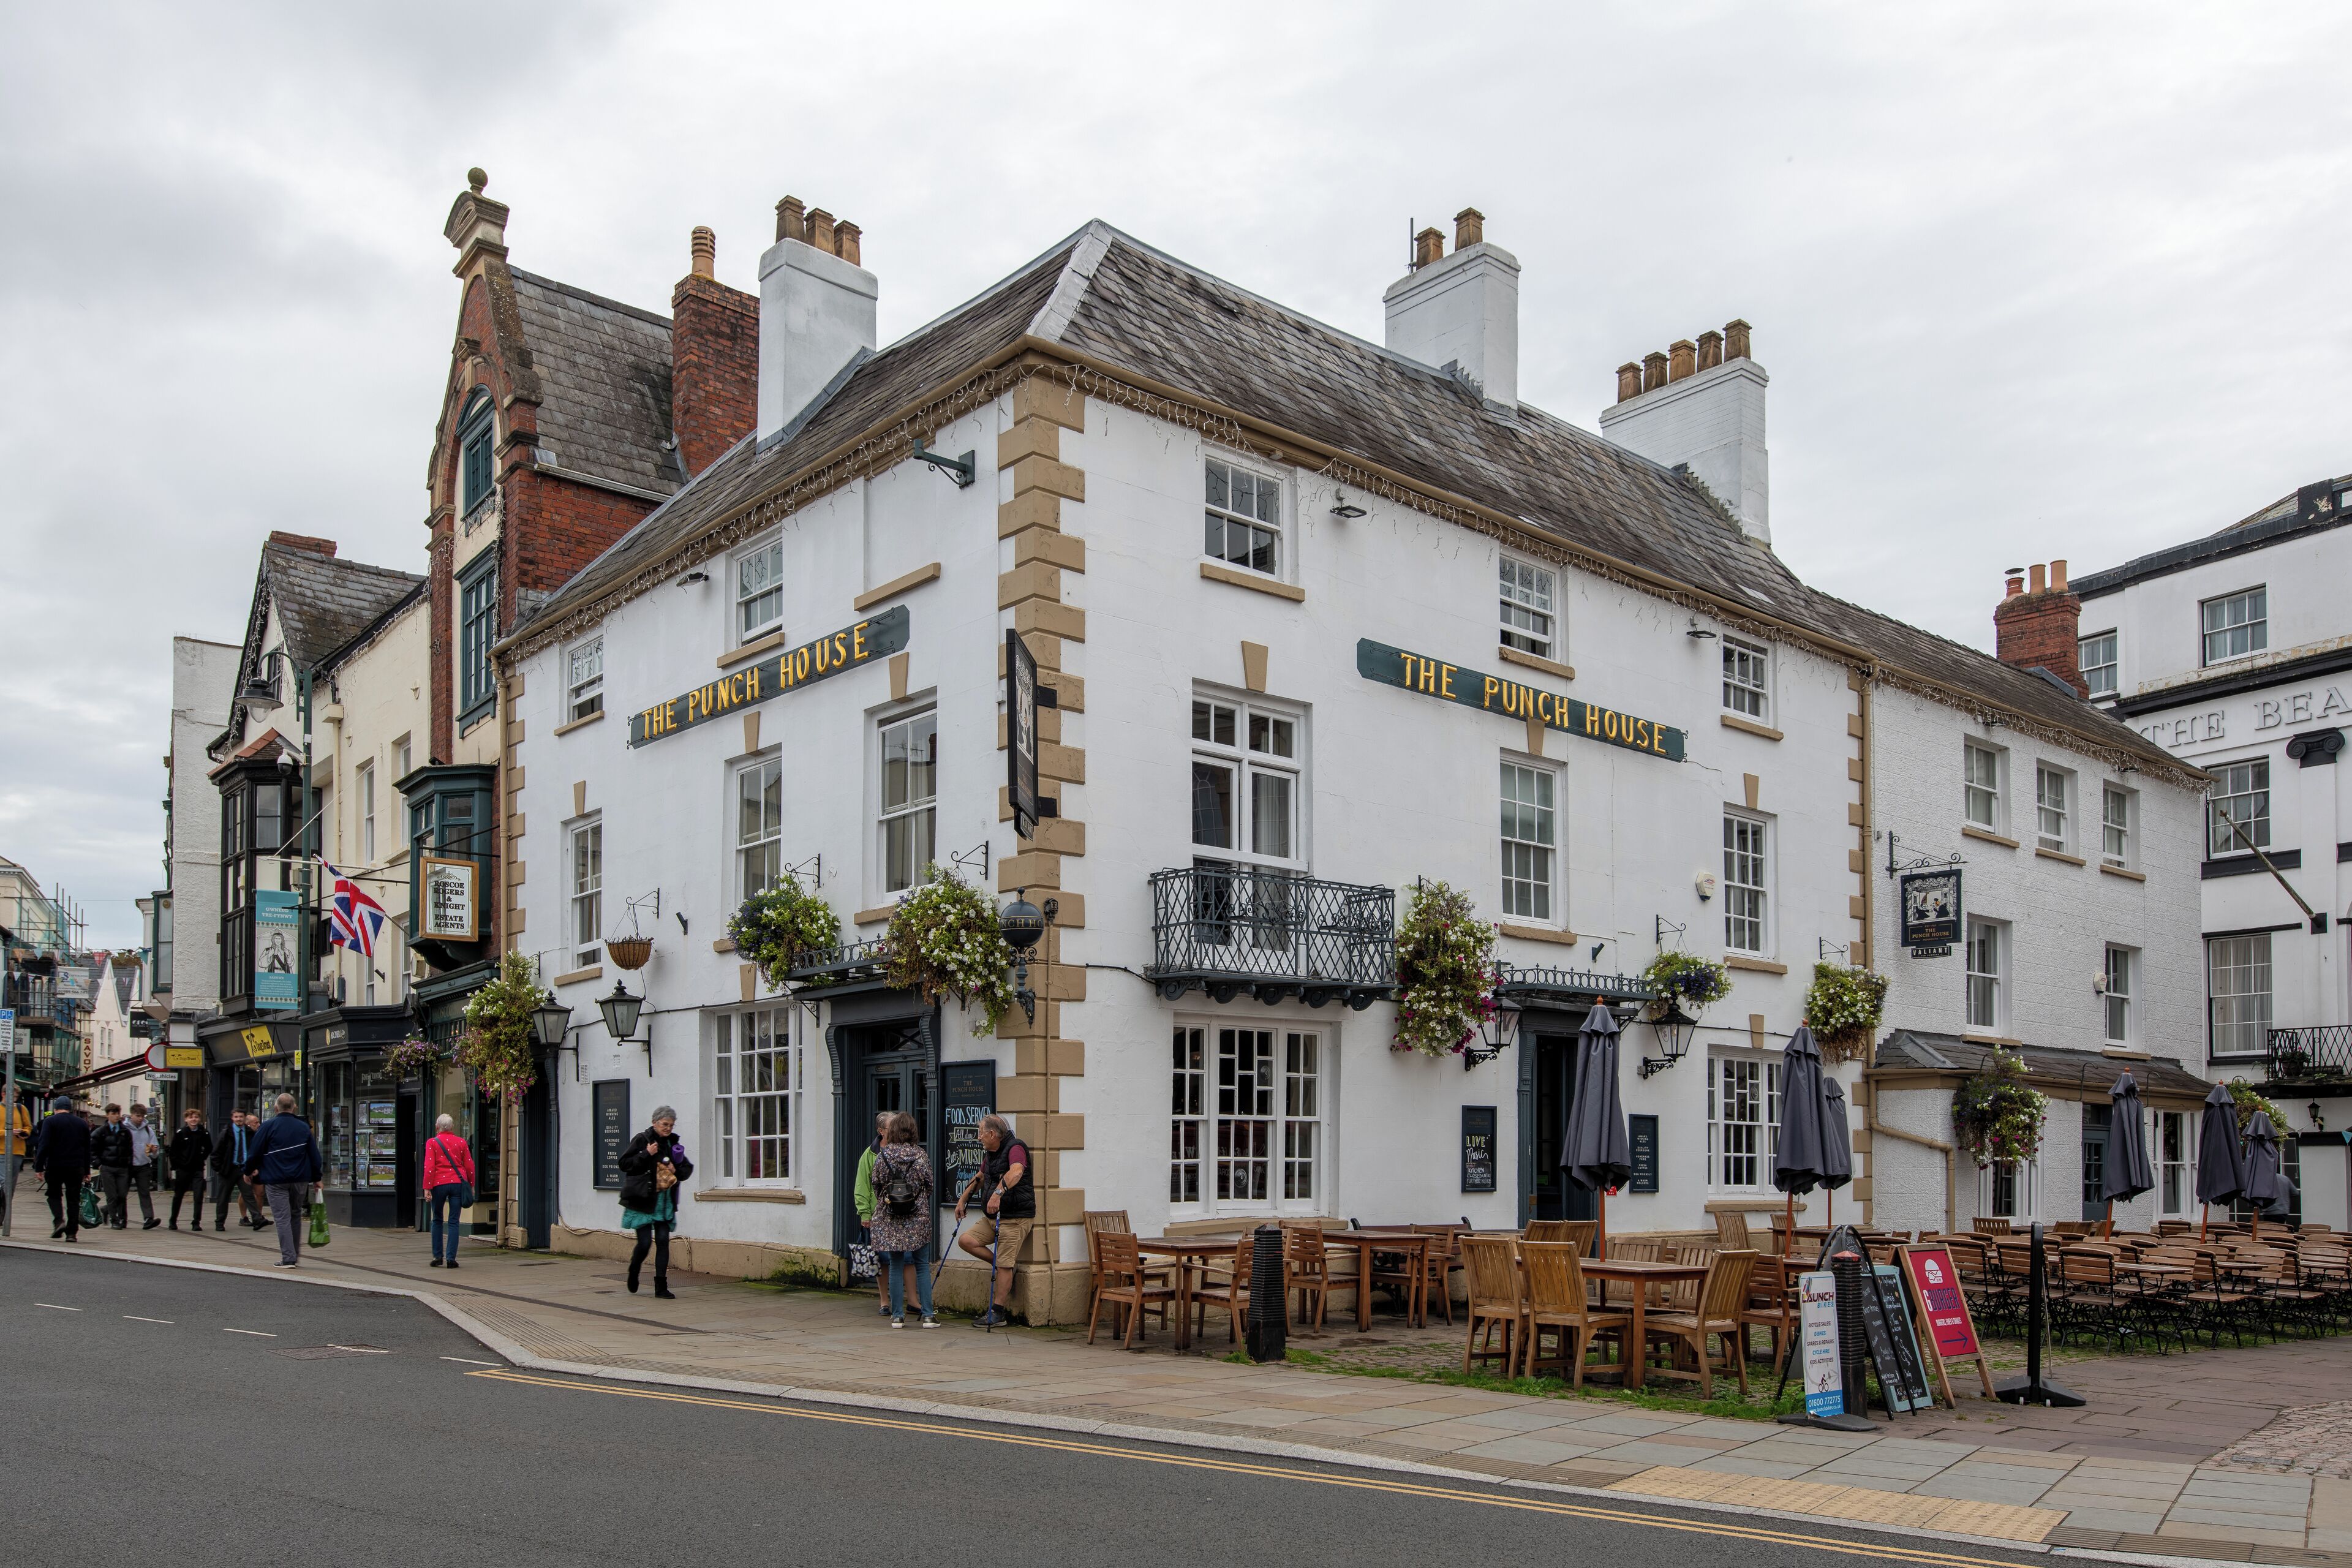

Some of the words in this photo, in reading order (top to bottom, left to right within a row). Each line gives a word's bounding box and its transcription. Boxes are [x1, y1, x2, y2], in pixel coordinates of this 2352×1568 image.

[642, 699, 677, 739] THE
[689, 667, 759, 722] PUNCH
[780, 622, 870, 689] HOUSE
[1401, 652, 1457, 699] THE
[1483, 676, 1569, 728] PUNCH
[1586, 704, 1666, 755] HOUSE
[2140, 710, 2225, 747] THE
[946, 1107, 965, 1125] FOOD
[955, 1129, 965, 1139] All
[965, 1129, 976, 1143] day
[1466, 1136, 1485, 1147] LIVE
[959, 1148, 986, 1165] MUSIC
[1466, 1147, 1488, 1164] Music
[1802, 1292, 1834, 1303] LAUNCH
[1808, 1398, 1823, 1408] 01600
[1825, 1396, 1841, 1404] 772775
